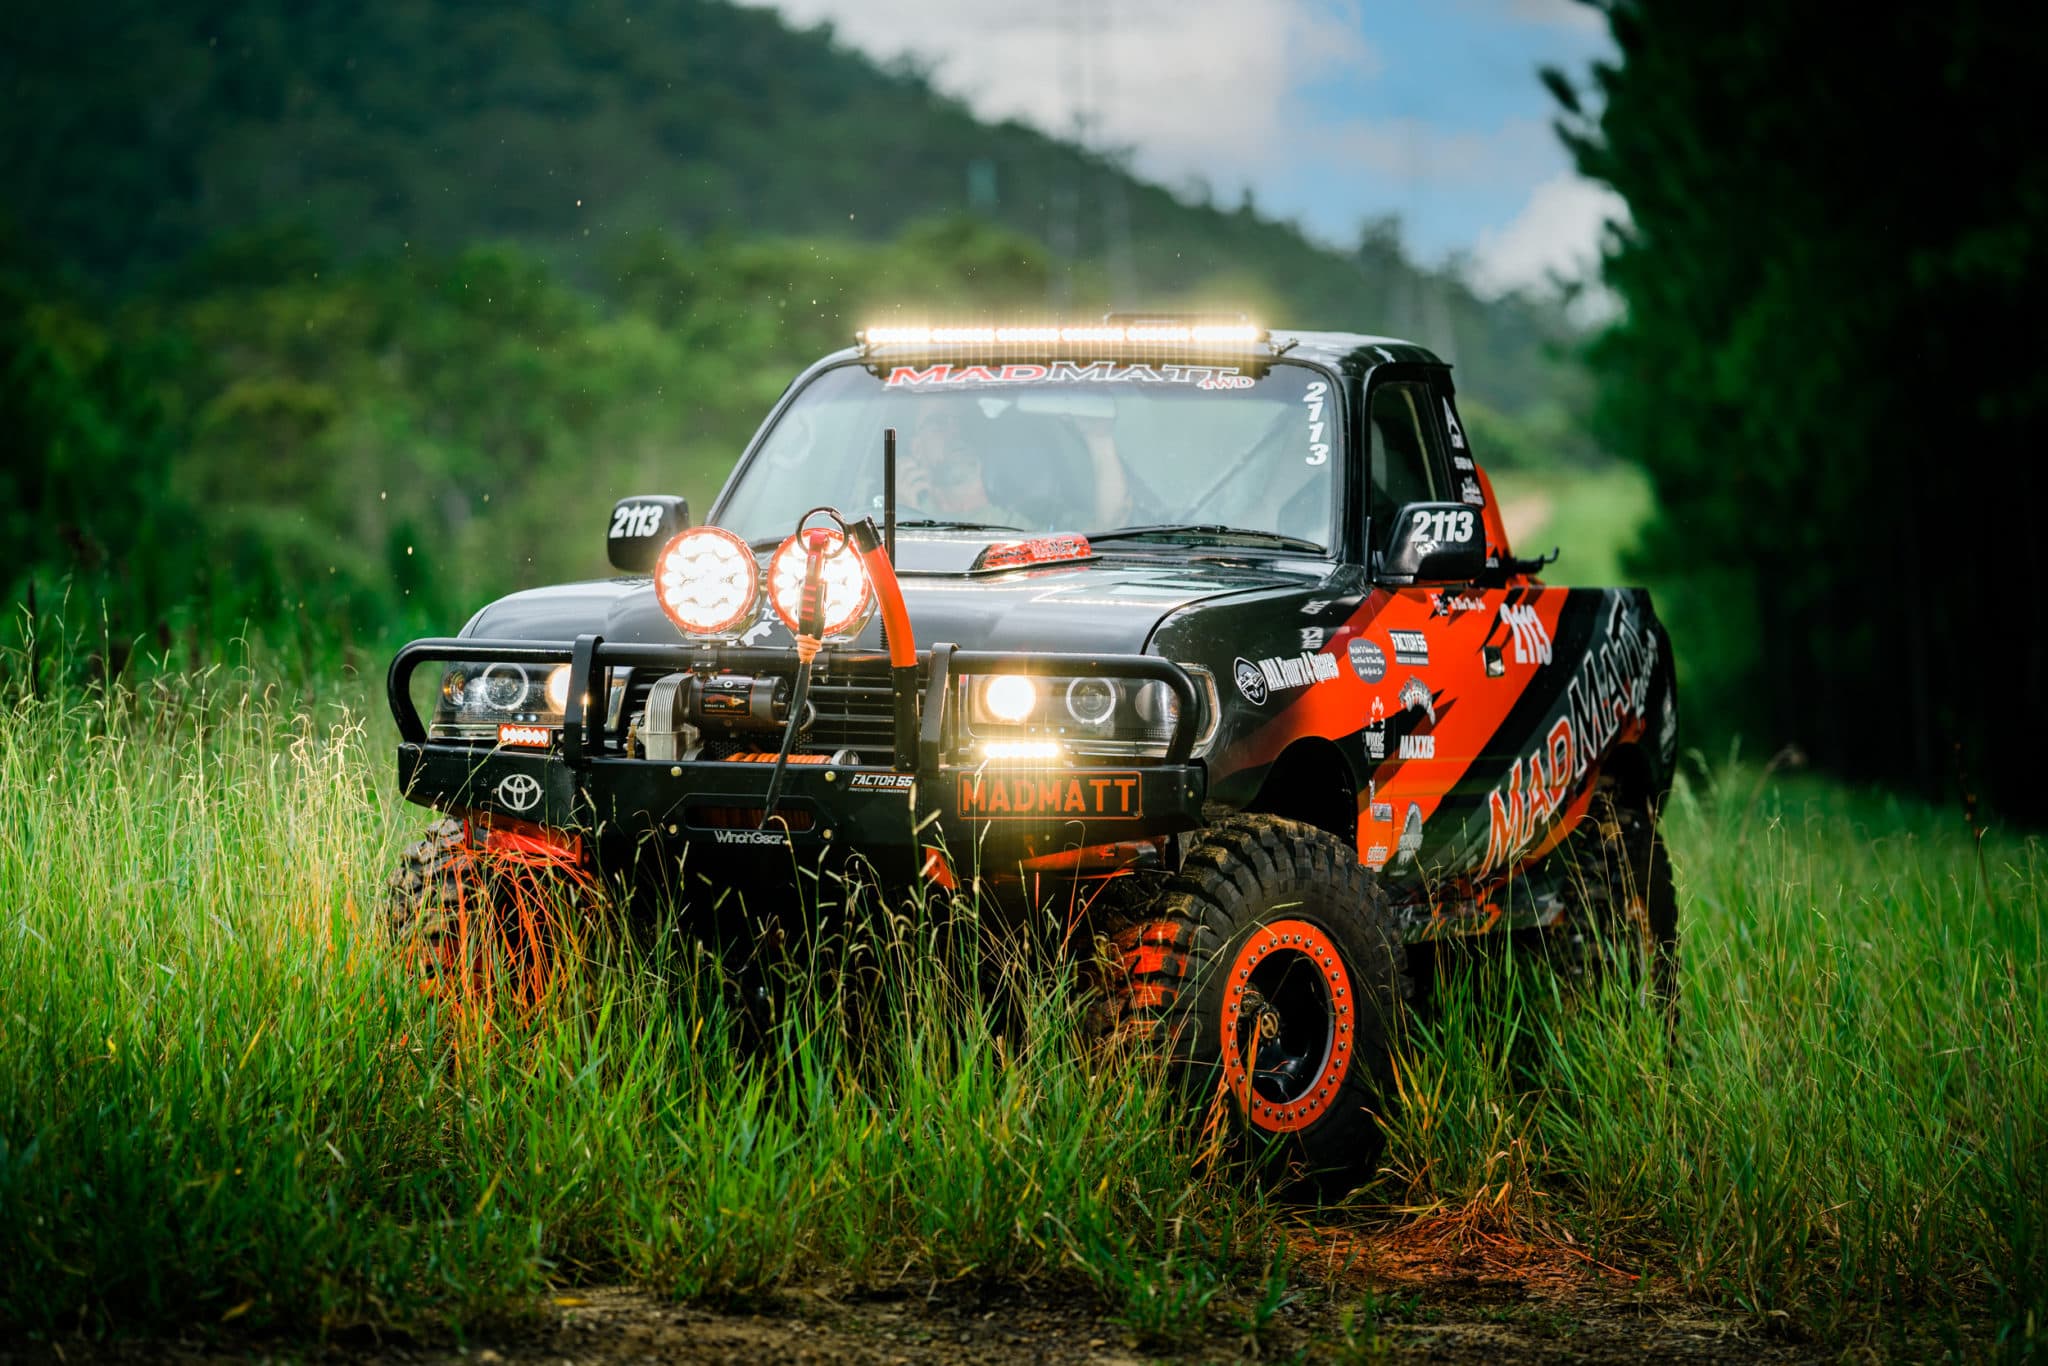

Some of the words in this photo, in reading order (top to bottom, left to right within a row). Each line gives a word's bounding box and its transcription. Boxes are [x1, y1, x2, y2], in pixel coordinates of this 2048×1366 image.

[885, 361, 1240, 387] MADMATT
[1197, 376, 1255, 390] 4WD
[1303, 381, 1329, 466] 2113
[609, 505, 664, 538] 2113
[1409, 510, 1475, 543] 2113
[1500, 603, 1552, 666] 2113
[1399, 735, 1435, 760] MAXXIS
[1473, 591, 1645, 882] MADMATT
[852, 774, 897, 786] FACTOR
[896, 776, 914, 787] 55
[963, 779, 1137, 812] MADMATT
[714, 830, 784, 845] WinchGear
